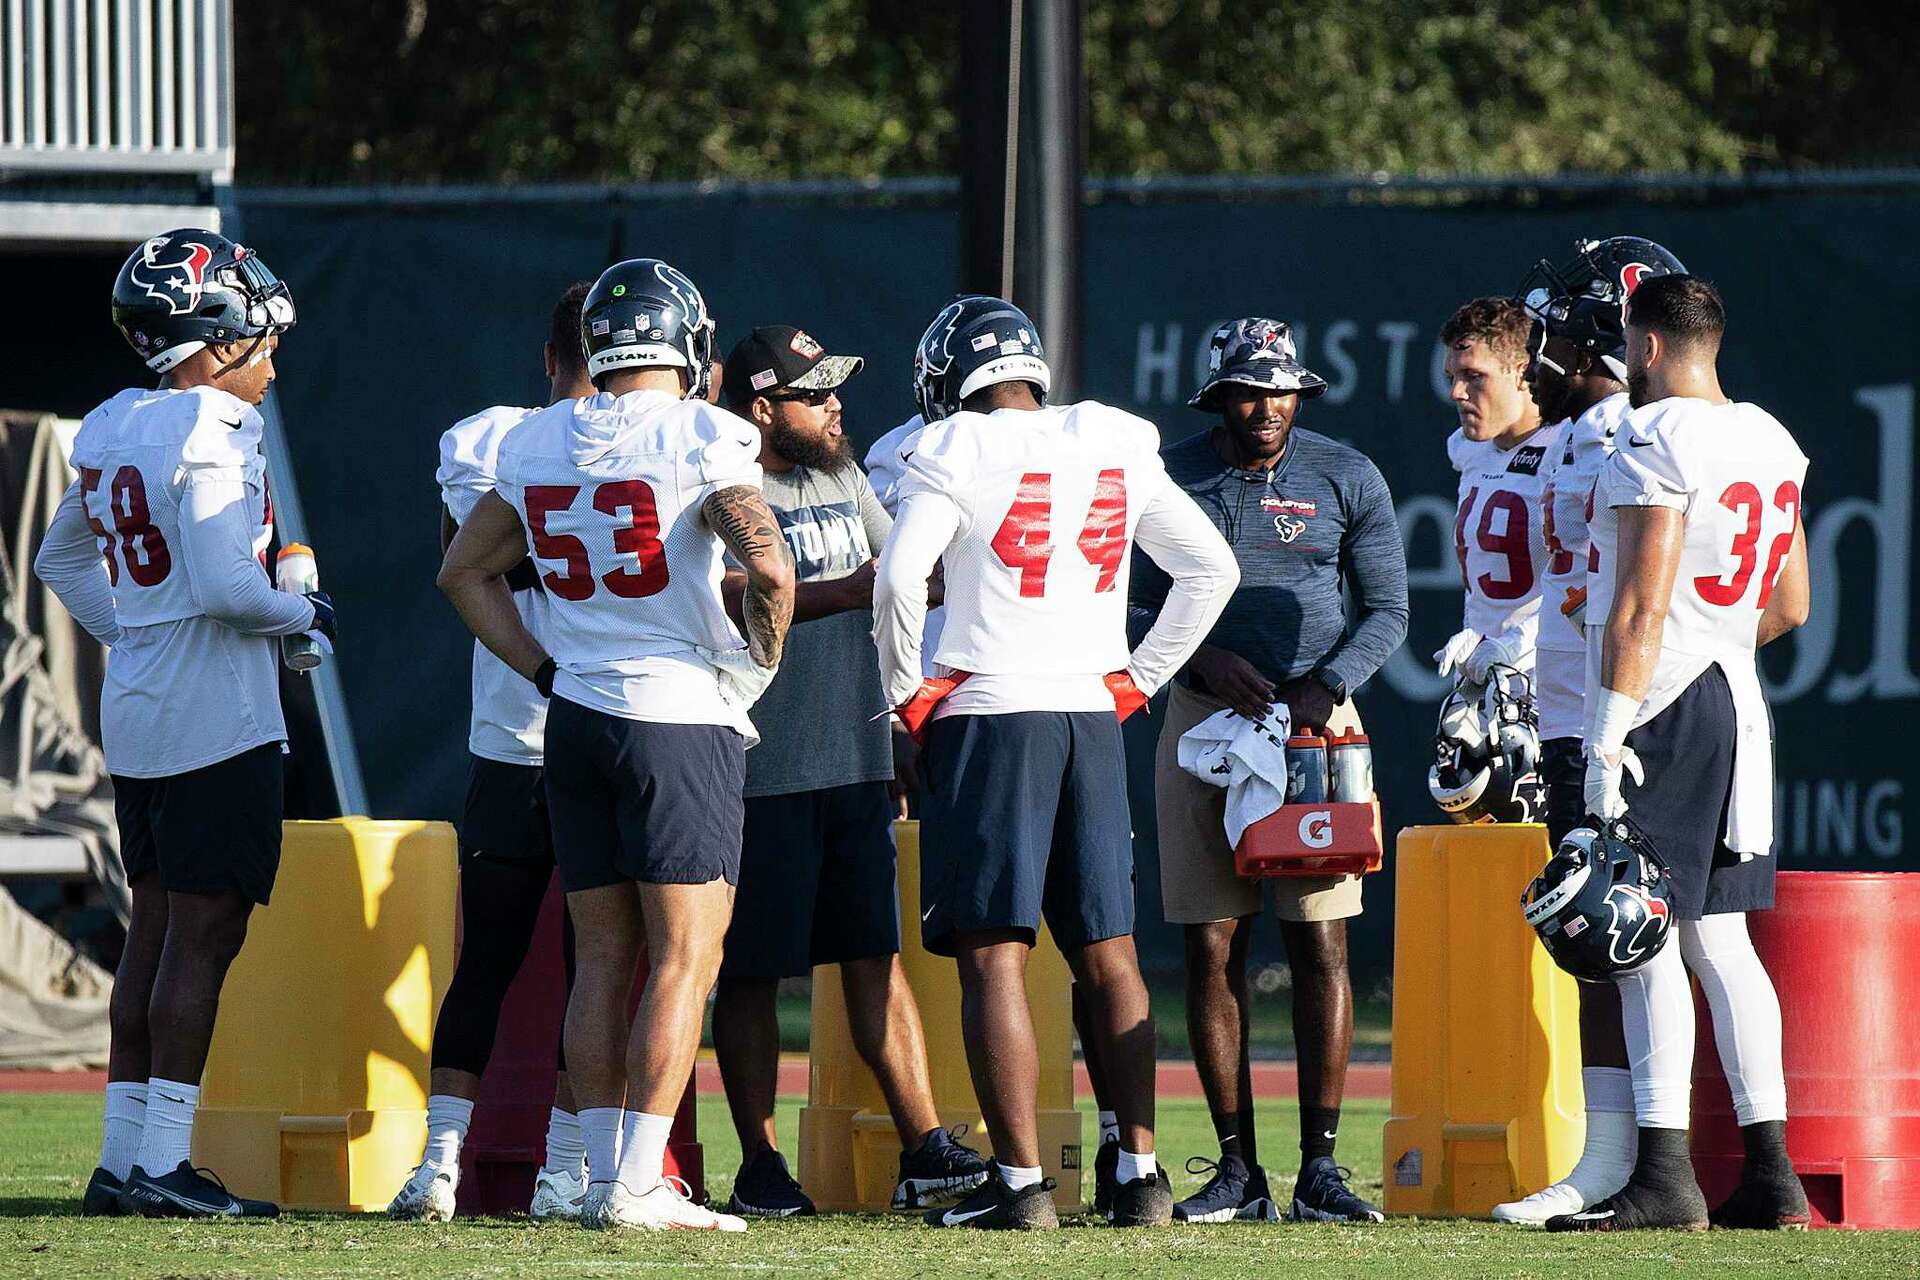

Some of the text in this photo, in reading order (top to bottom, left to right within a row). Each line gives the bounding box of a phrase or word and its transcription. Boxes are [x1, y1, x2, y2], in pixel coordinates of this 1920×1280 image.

[597, 353, 658, 365] TEXANS
[80, 465, 171, 587] 58
[524, 479, 670, 601] 53
[990, 468, 1128, 598] 44
[1261, 498, 1316, 509] HOUSTON
[1694, 480, 1799, 609] 32
[1299, 801, 1333, 849] G
